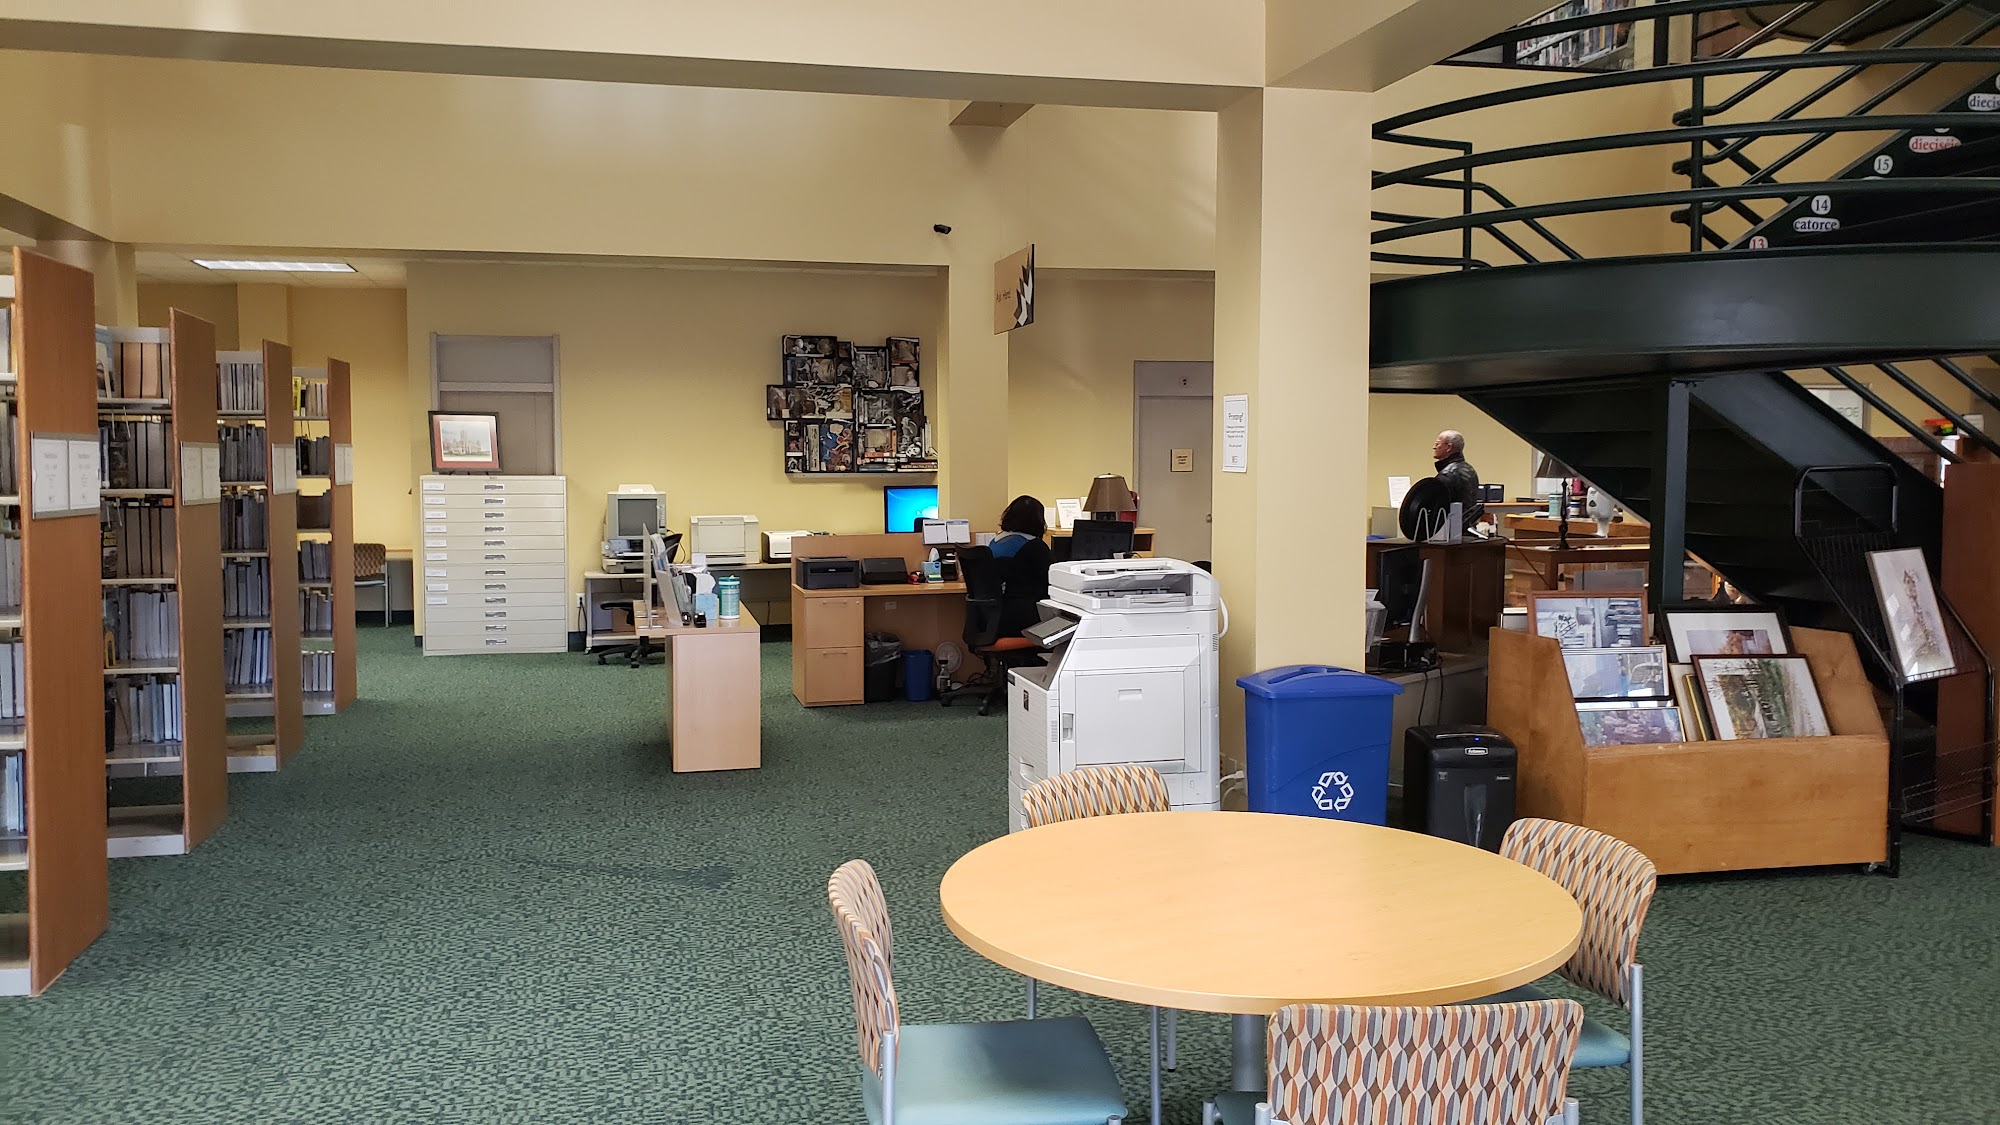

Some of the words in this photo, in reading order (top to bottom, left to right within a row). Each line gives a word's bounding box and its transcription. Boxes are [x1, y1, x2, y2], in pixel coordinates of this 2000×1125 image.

[1876, 157, 1889, 171] 15
[1815, 199, 1829, 211] 14
[1794, 220, 1837, 230] catorce
[1752, 238, 1765, 249] 13
